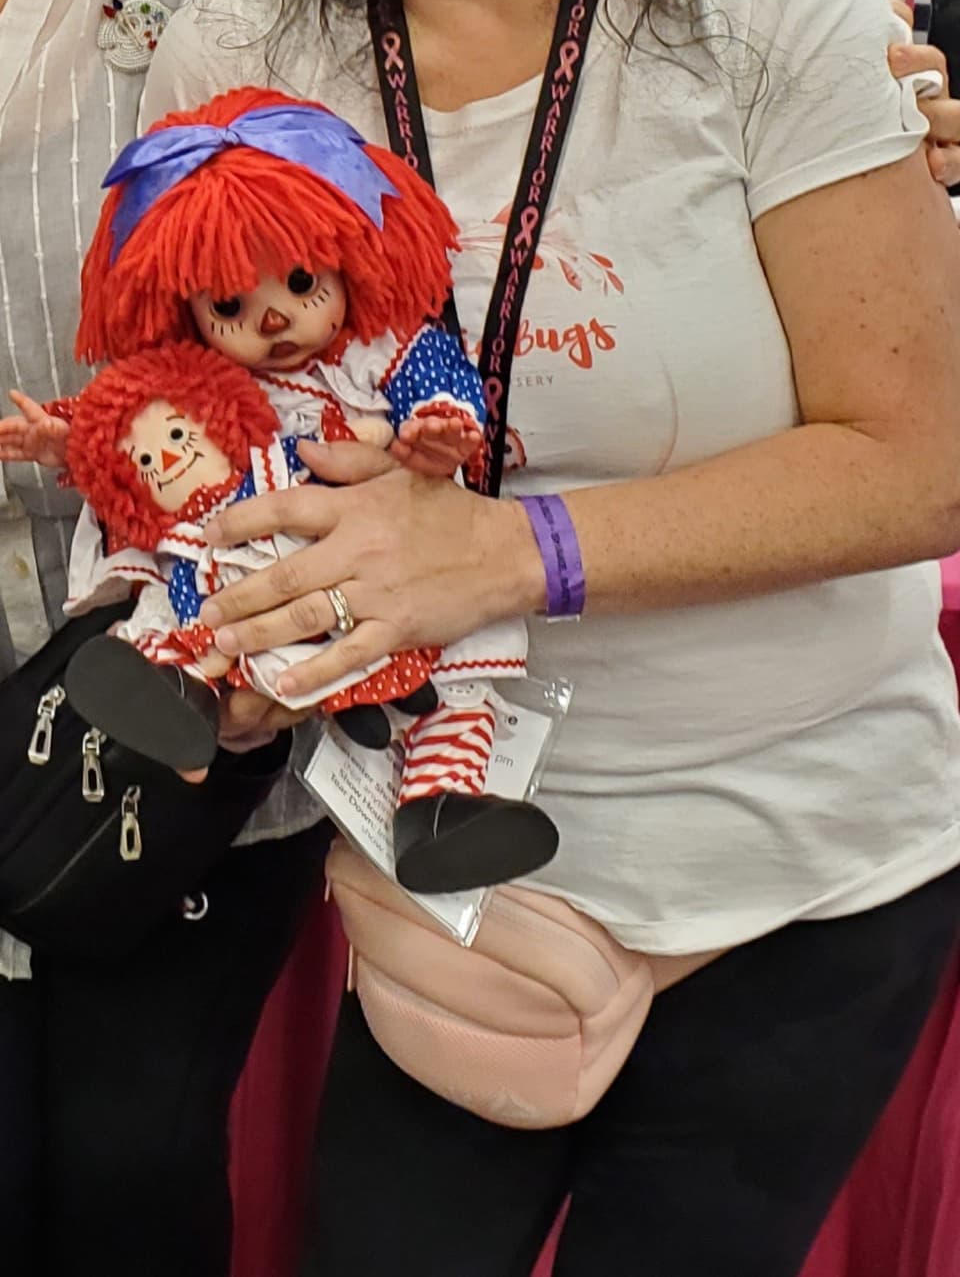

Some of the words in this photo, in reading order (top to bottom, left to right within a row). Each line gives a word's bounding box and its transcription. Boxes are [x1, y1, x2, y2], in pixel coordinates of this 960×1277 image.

[528, 83, 571, 204] WARRIOR
[490, 247, 529, 373] WARRIOR
[514, 317, 617, 369] Bugs
